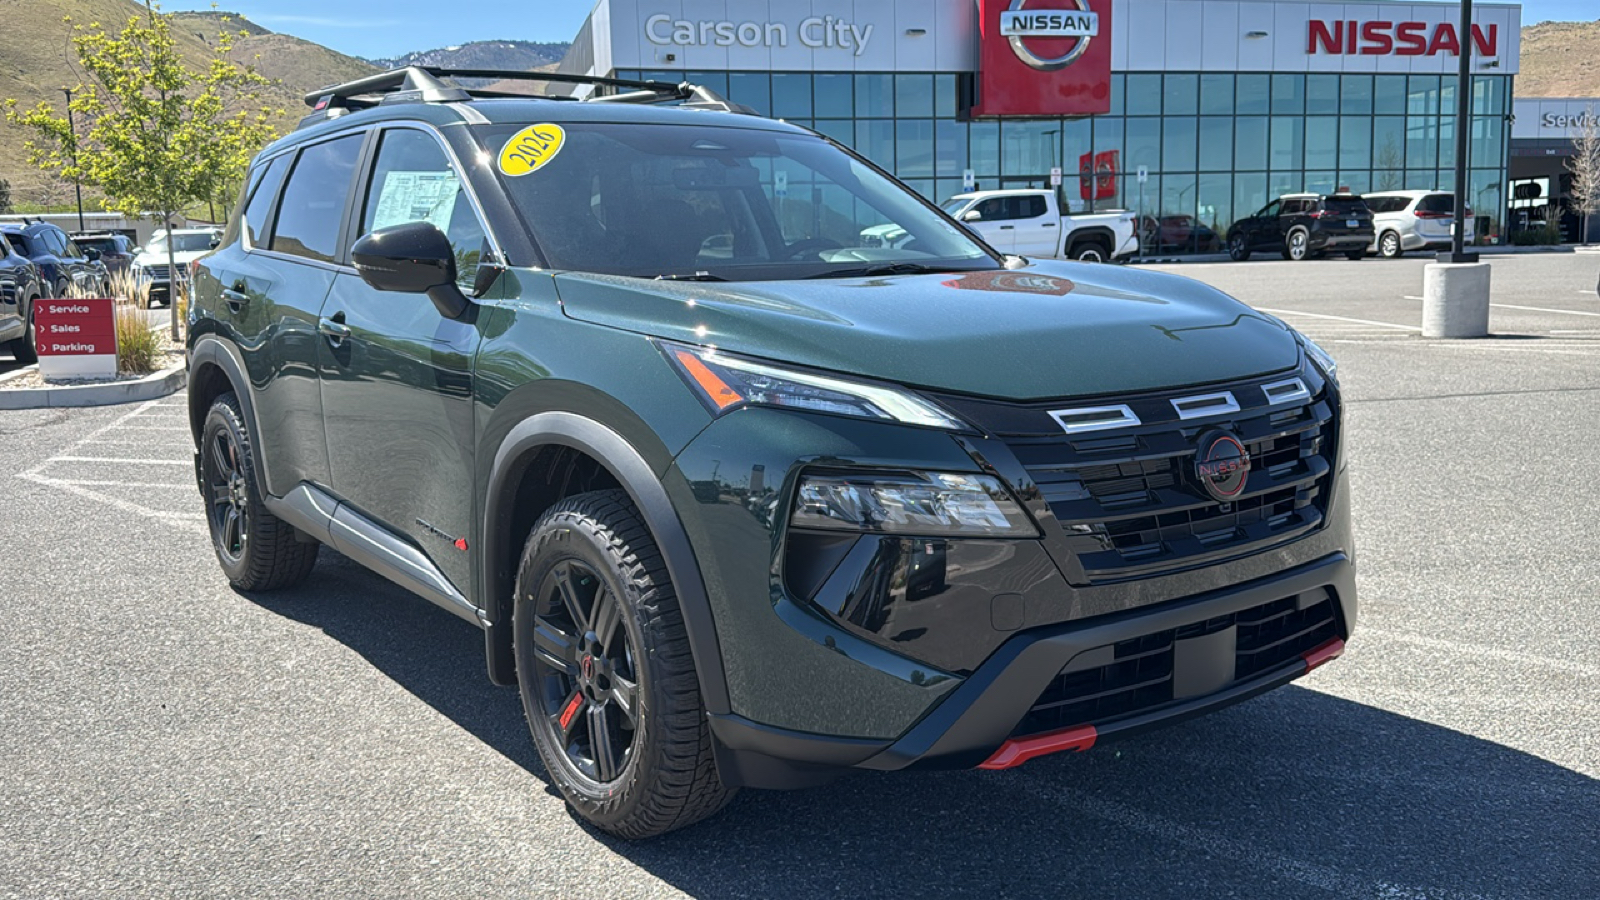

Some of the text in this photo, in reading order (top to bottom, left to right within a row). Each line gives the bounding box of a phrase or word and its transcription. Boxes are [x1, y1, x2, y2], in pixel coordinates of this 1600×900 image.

[1012, 15, 1091, 31] NISSAN
[645, 13, 873, 56] Carson City
[1307, 19, 1498, 57] NISSAN
[508, 128, 556, 168] 2026
[48, 304, 90, 314] Service
[50, 324, 80, 333] Sales
[52, 342, 95, 353] Parking
[1199, 458, 1247, 475] NISS
